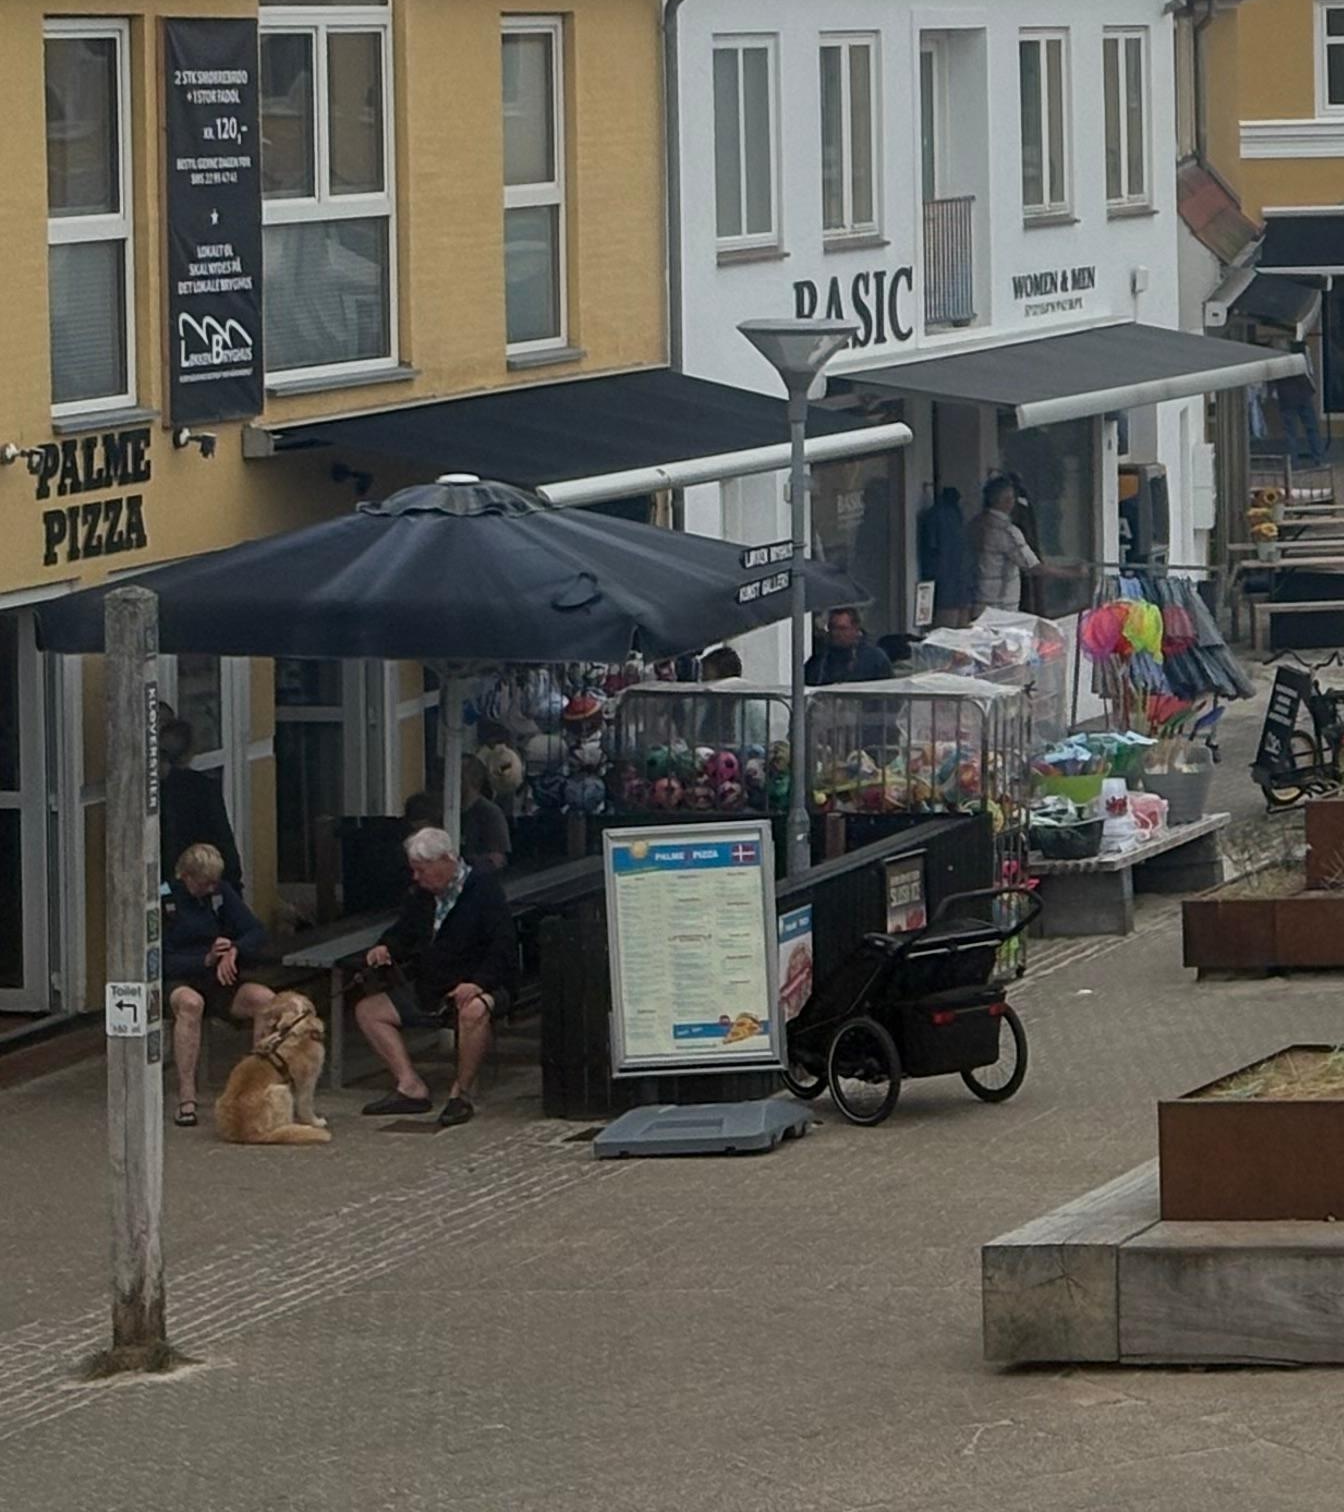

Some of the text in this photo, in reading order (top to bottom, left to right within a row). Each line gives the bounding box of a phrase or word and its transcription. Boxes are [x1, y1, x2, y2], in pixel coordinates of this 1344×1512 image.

[174, 70, 181, 85] 2
[1012, 265, 1095, 301] WOMEN & MEN
[36, 428, 152, 500] PALME
[43, 494, 147, 567] PIZZA
[110, 985, 142, 997] Toilet
